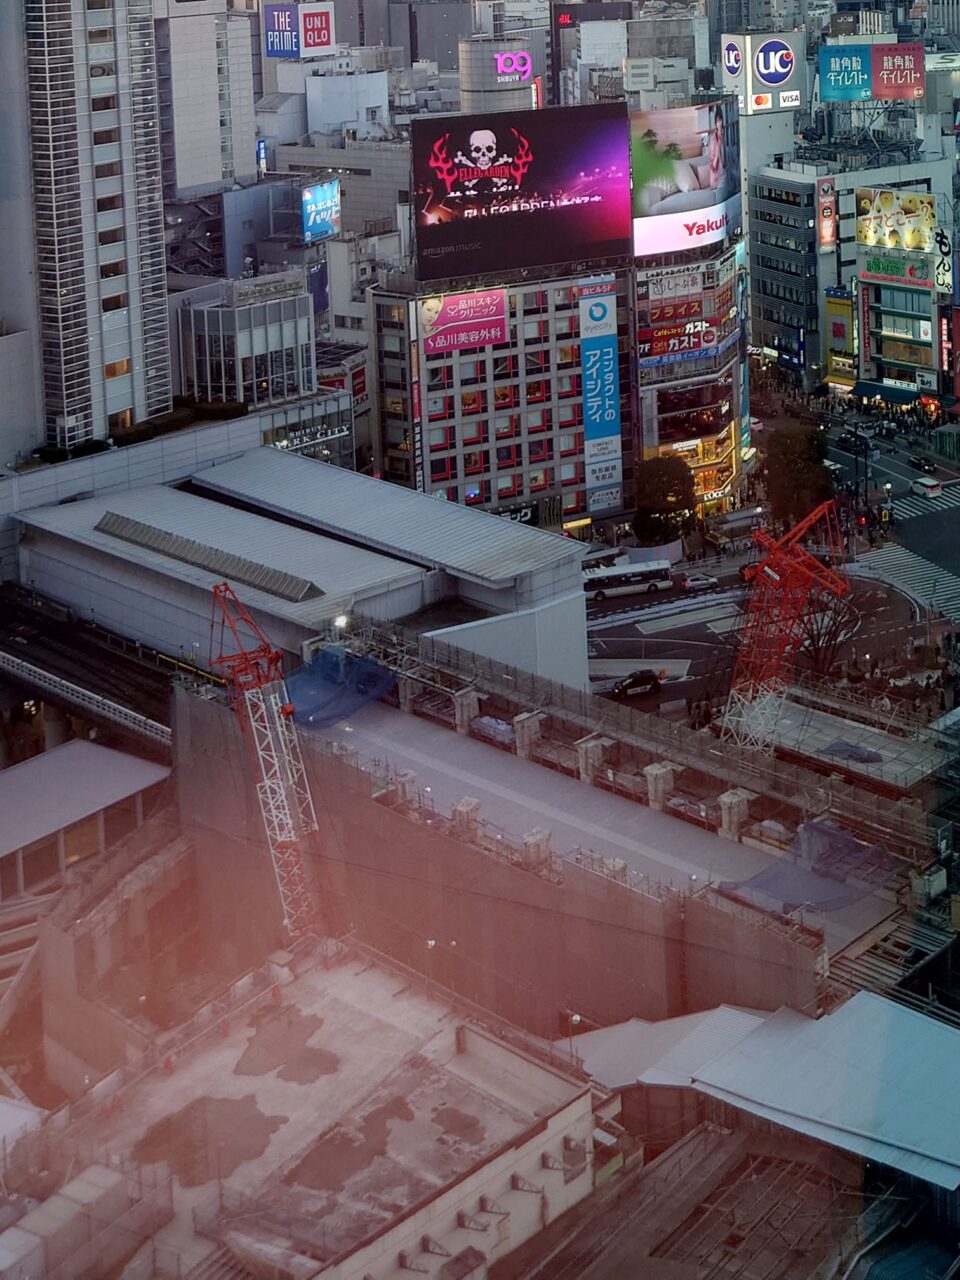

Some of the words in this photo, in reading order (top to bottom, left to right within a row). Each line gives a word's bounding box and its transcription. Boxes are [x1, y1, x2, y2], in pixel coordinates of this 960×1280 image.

[273, 12, 291, 31] THE
[306, 17, 326, 29] UNI
[268, 31, 298, 51] PRIME
[306, 31, 328, 45] QLO
[493, 51, 532, 81] 109
[830, 56, 862, 71] 龍角散
[883, 55, 914, 70] 龍角散
[497, 75, 520, 83] SHIBUYA
[782, 94, 800, 103] VISA
[459, 166, 510, 180] ELLEGARDEN
[684, 213, 729, 237] Yakult
[422, 246, 456, 257] amazon
[456, 241, 483, 252] music
[935, 228, 952, 293] もんじゃ
[637, 285, 648, 295] 9F
[458, 295, 501, 309] 品川スキン
[460, 305, 497, 319] クリニック
[584, 322, 613, 333] eyecity
[685, 320, 709, 334] ガスト
[436, 327, 501, 348] 品川美容外科
[668, 335, 699, 351] ガスト
[639, 343, 651, 353] 7F
[585, 349, 603, 423] アイシティ
[603, 347, 616, 421] コンタクトの
[289, 423, 327, 438] SHIBUYA
[316, 424, 350, 439] CITY
